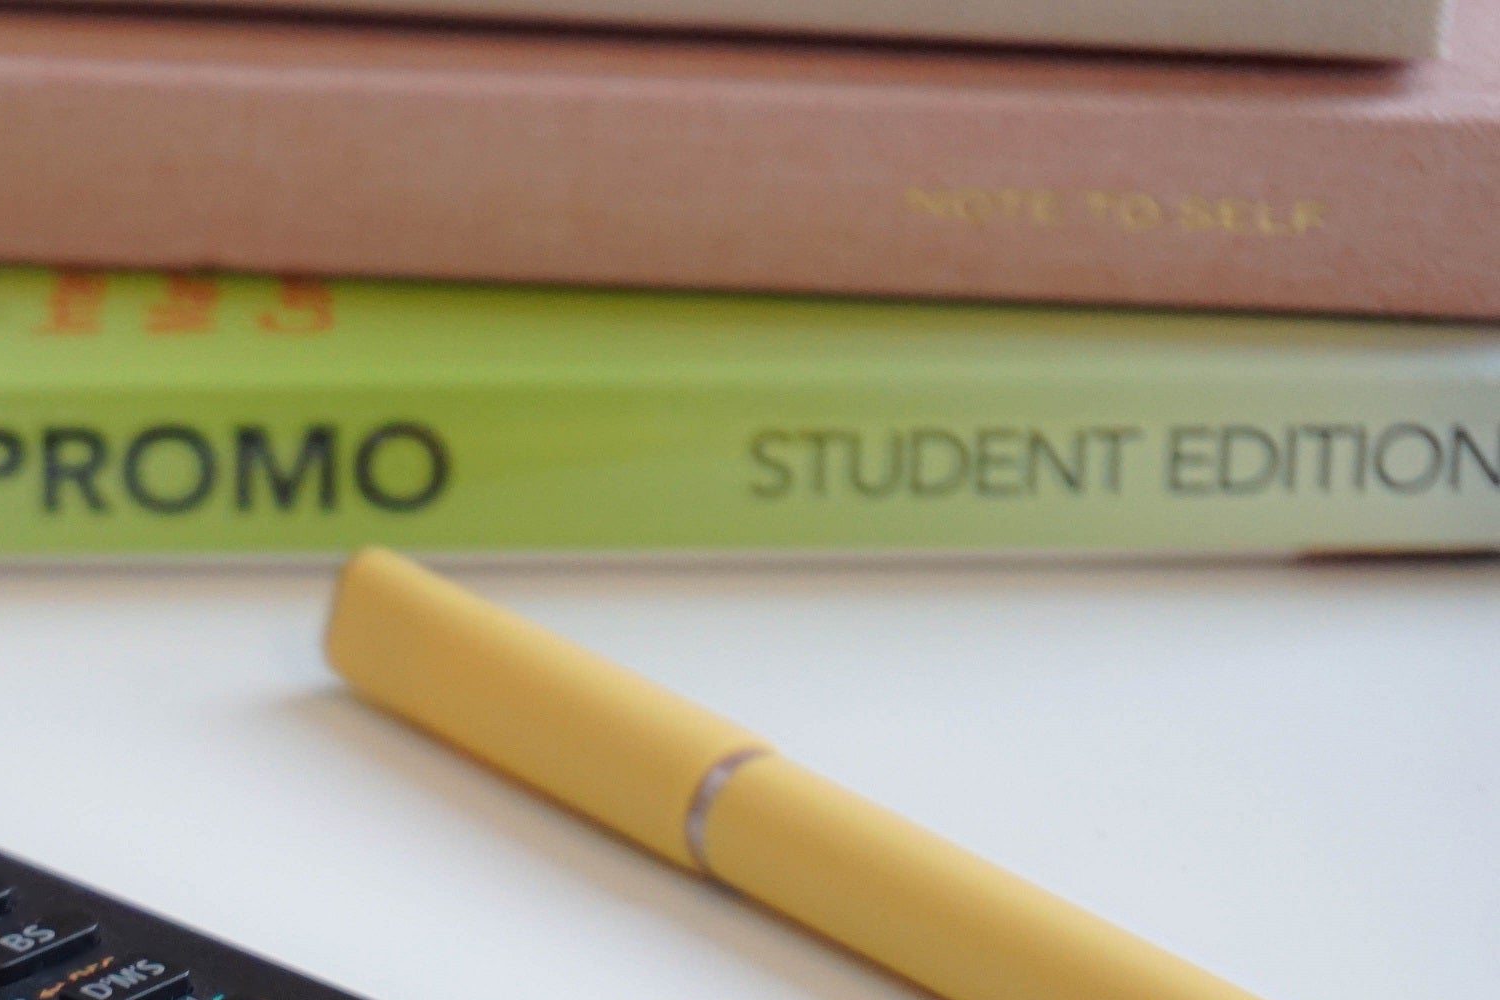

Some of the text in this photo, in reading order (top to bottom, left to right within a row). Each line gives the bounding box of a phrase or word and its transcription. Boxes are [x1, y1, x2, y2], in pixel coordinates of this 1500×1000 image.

[904, 185, 1326, 237] NOTE TO SELF
[748, 421, 1500, 501] STUDENT EDITION
